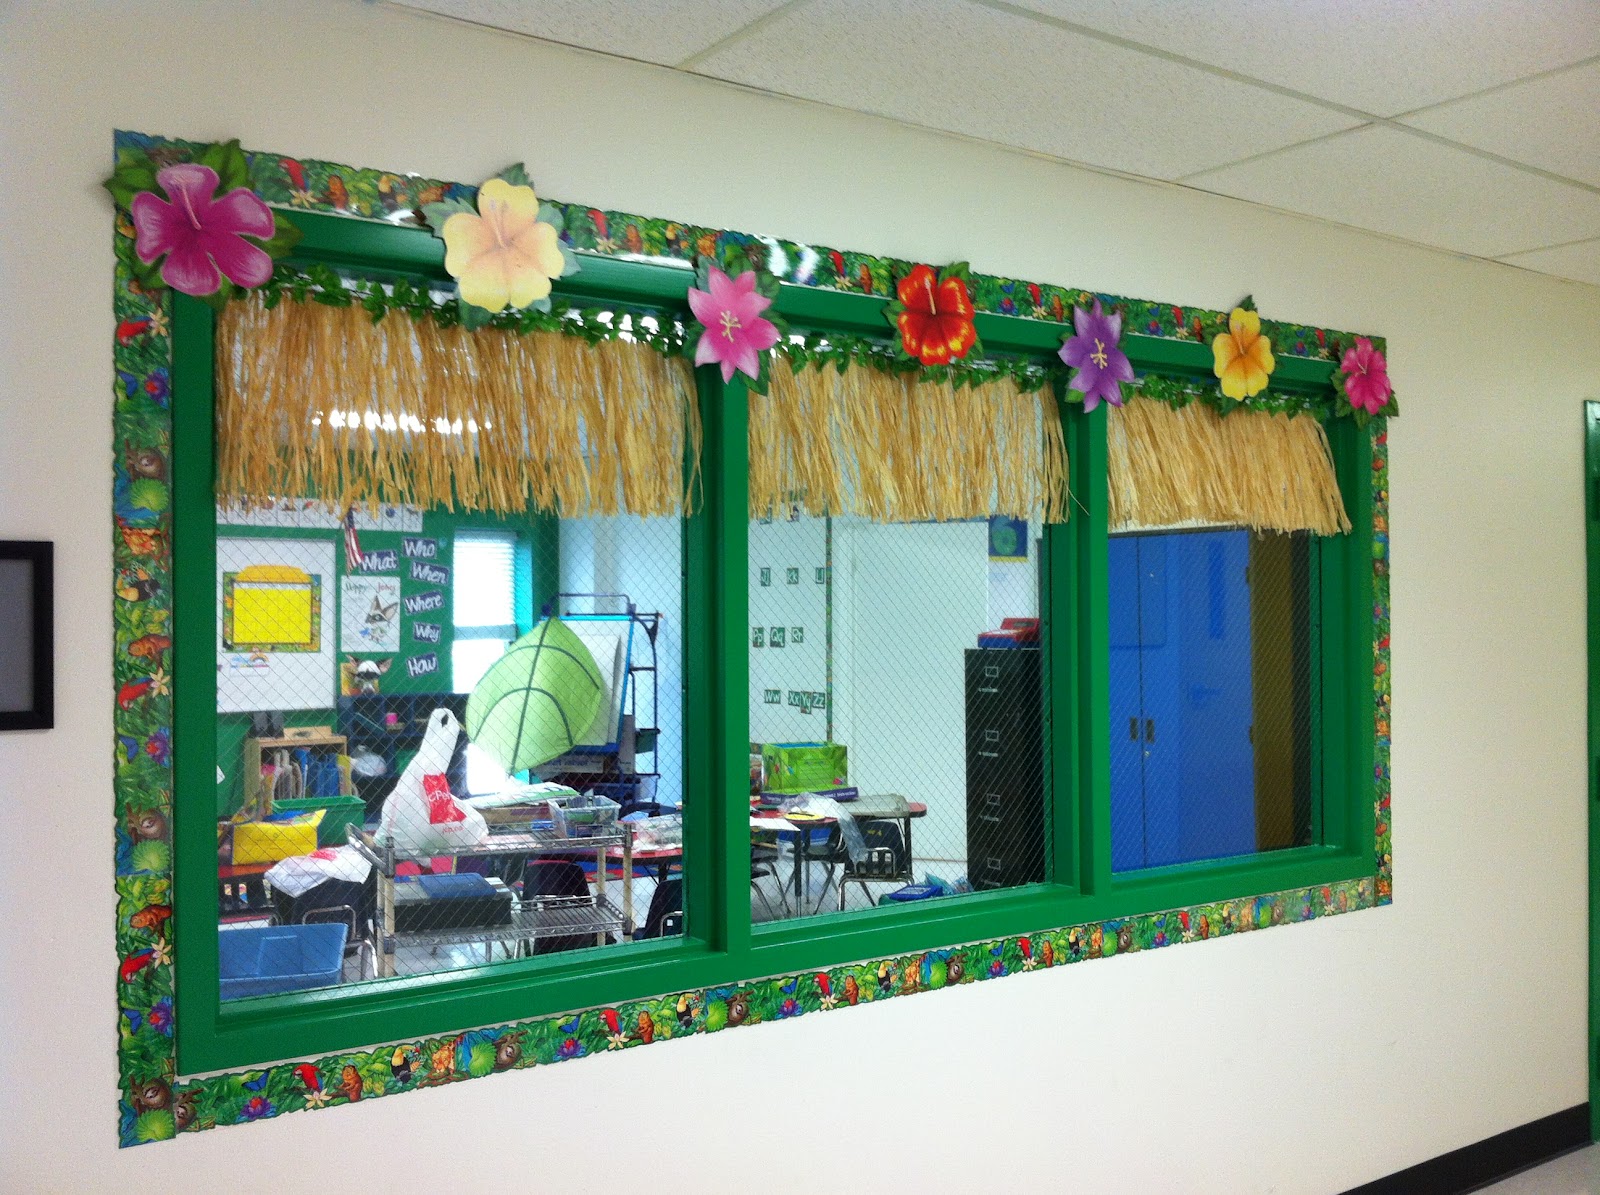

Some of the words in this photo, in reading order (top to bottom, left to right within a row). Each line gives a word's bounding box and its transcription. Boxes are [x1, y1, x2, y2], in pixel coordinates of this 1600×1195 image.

[403, 539, 435, 558] Who
[361, 551, 397, 571] What
[412, 561, 446, 584] When
[405, 593, 442, 613] Where
[414, 623, 440, 643] Why
[407, 657, 437, 676] How
[764, 690, 780, 703] Ww
[788, 692, 800, 705] Xx
[801, 692, 811, 713] Yy
[812, 693, 825, 707] Zz
